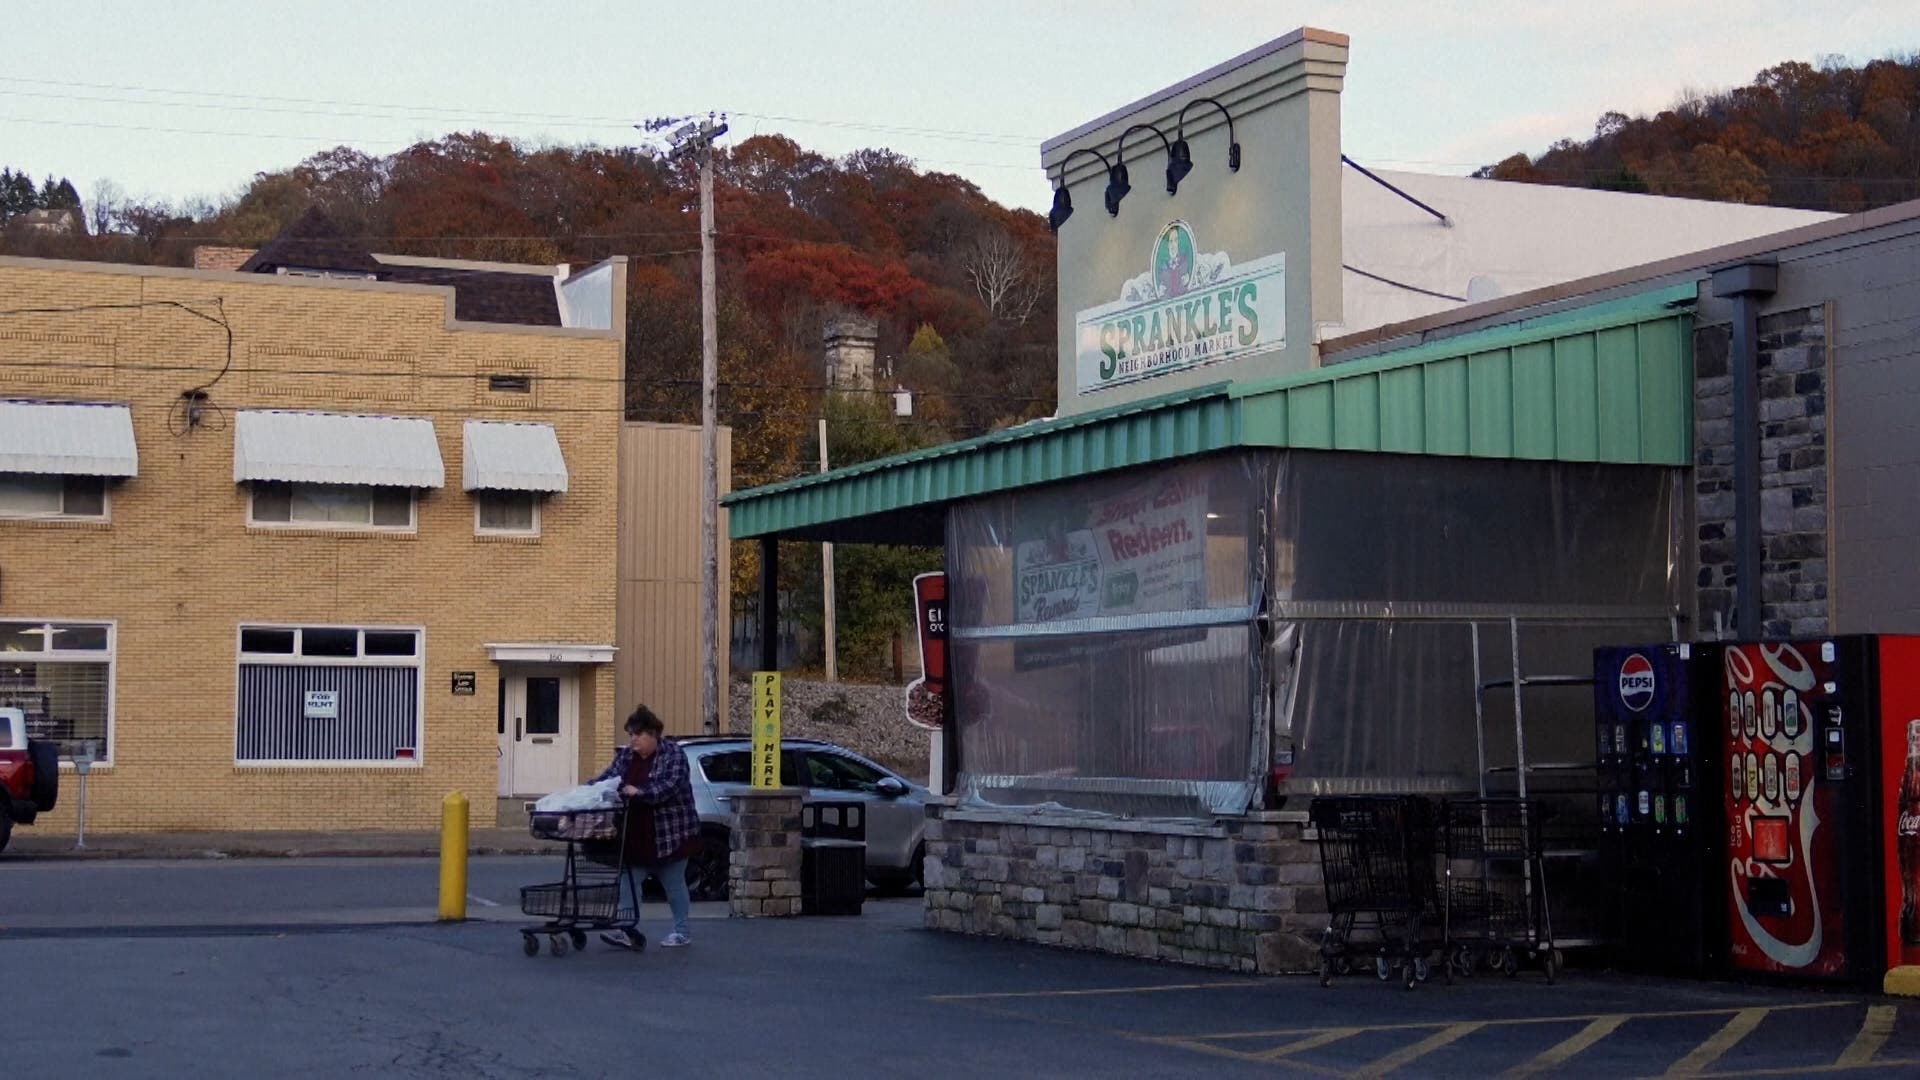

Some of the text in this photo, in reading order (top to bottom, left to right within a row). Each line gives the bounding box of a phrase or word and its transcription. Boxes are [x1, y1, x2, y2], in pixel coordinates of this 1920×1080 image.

[1100, 283, 1258, 380] SPRANKLE'S
[1118, 335, 1234, 374] NEIGHBORHOOD MARKET
[1621, 677, 1653, 690] PEPSI
[764, 675, 775, 786] PLAY HERE
